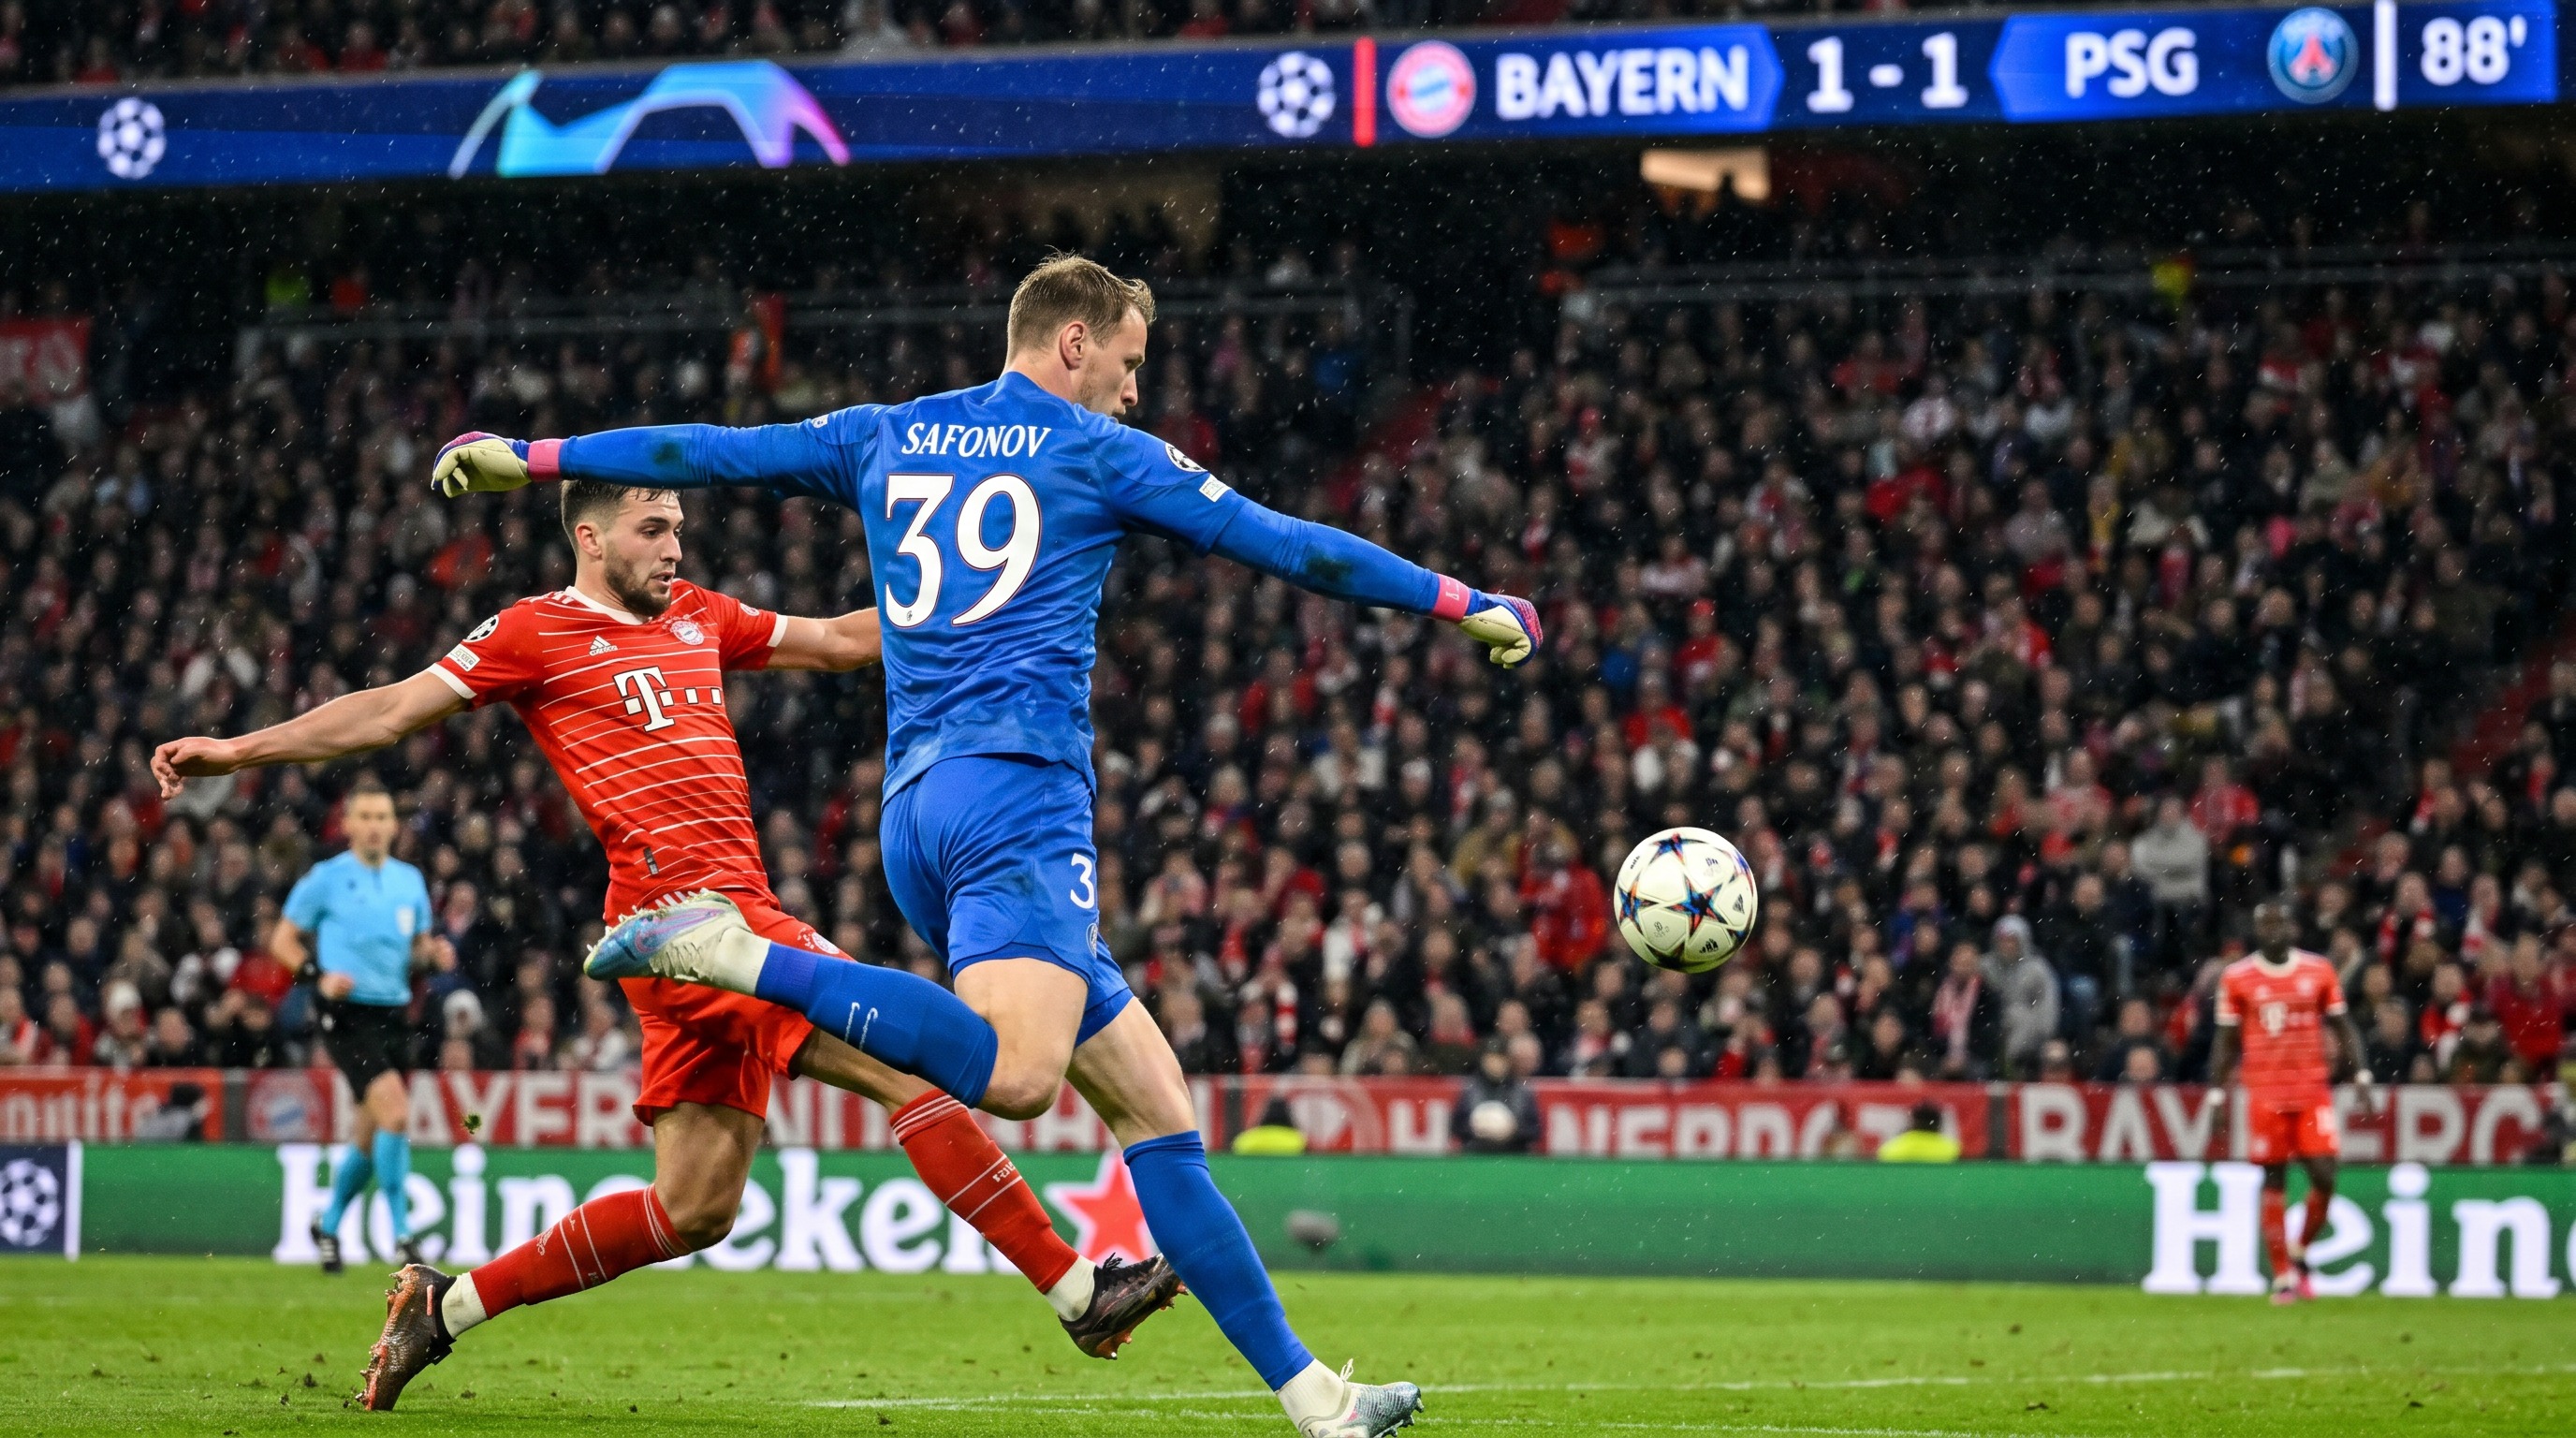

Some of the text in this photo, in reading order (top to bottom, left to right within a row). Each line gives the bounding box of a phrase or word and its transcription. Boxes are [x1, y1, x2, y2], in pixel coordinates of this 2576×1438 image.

[1497, 14, 2527, 120] BAYERN 1 - 1 PSG 88'
[901, 422, 1052, 458] SAFONOV
[886, 473, 1042, 629] 39
[1070, 853, 1095, 909] 3
[2142, 1161, 2576, 1299] Hein
